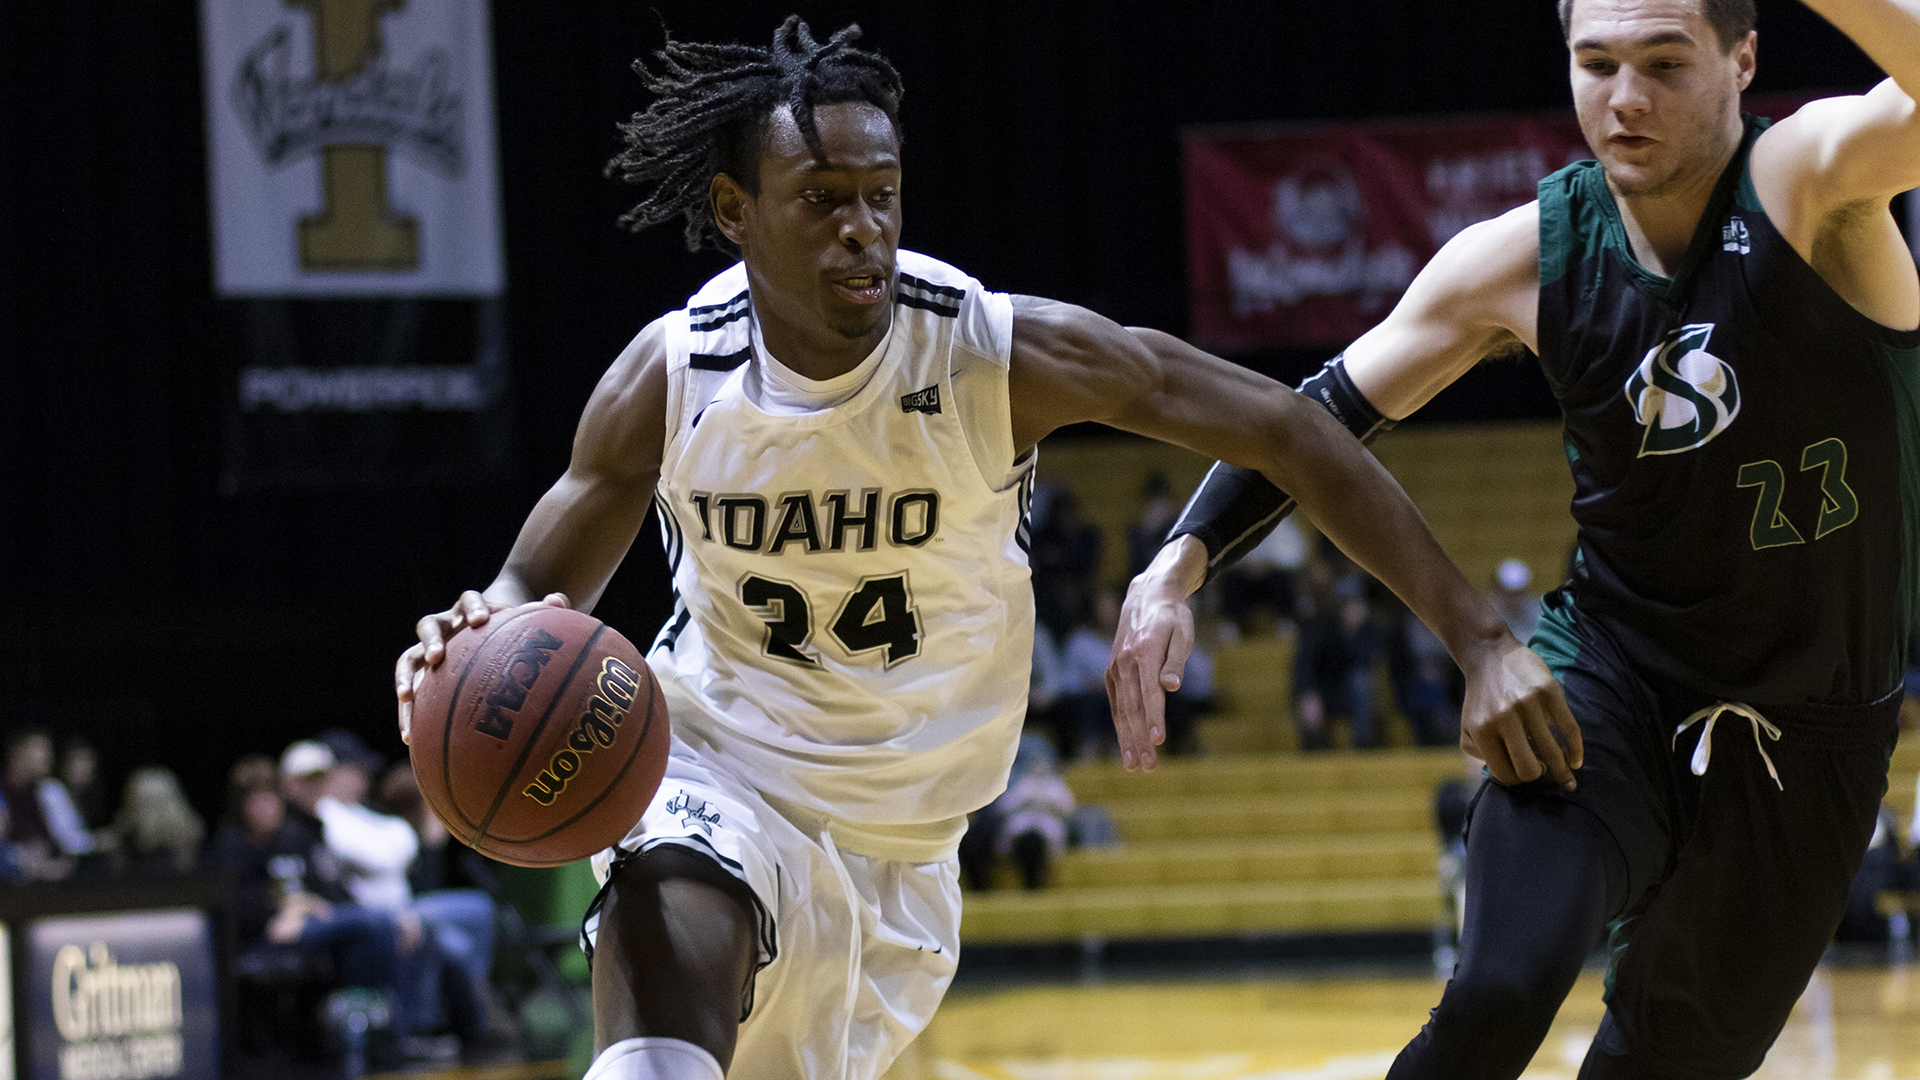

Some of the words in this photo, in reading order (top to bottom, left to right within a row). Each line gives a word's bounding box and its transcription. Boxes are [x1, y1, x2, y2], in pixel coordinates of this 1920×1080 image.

[689, 487, 941, 556] IDAHO
[1737, 438, 1858, 550] 23
[736, 569, 925, 672] 24
[475, 629, 563, 741] NCAA
[522, 656, 641, 806] Wilson
